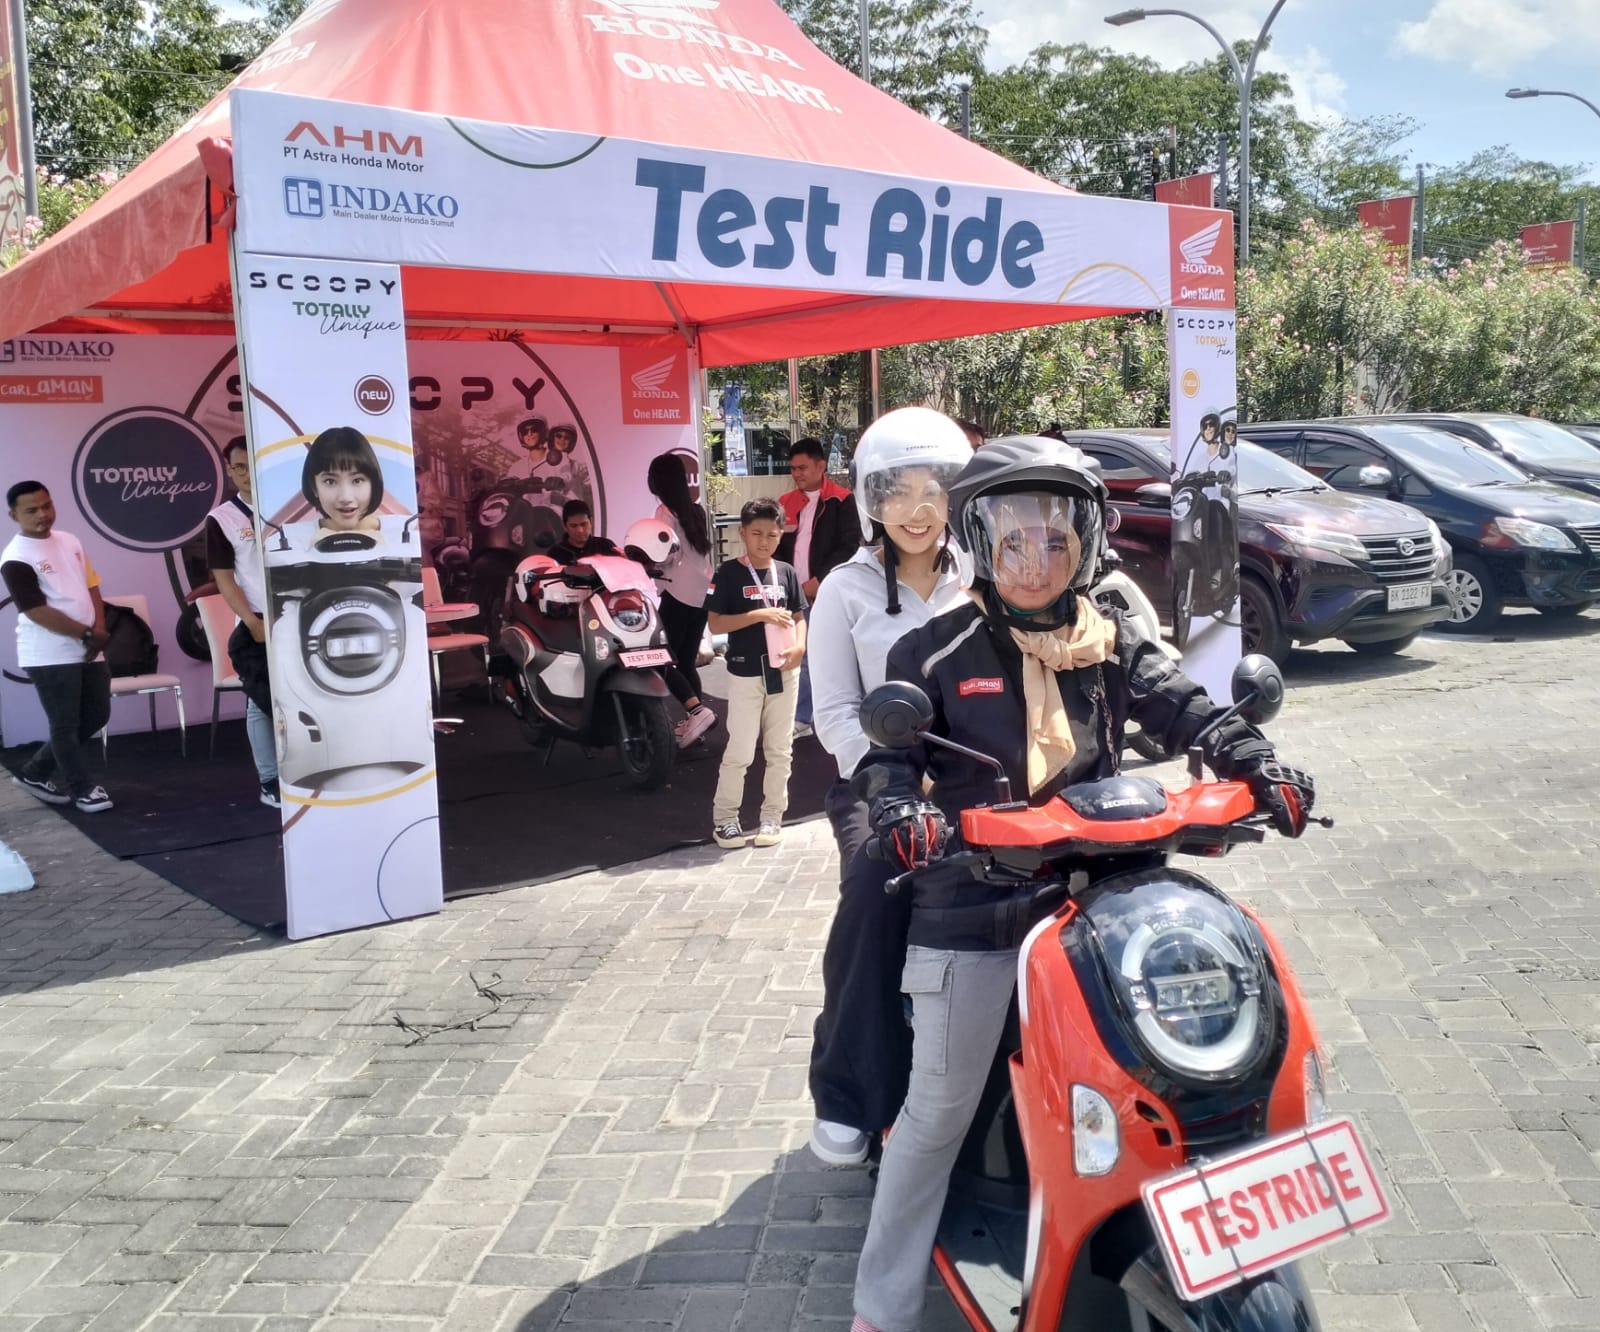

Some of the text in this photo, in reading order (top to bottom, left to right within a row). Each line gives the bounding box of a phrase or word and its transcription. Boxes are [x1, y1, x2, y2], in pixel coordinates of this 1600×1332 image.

[582, 14, 806, 71] HONDA
[612, 52, 707, 87] One
[284, 121, 424, 158] AHM
[283, 146, 425, 173] PT Astra Honda Motor
[327, 183, 459, 219] INDAKO
[333, 209, 352, 219] Main
[354, 211, 378, 221] Dealer
[380, 214, 402, 224] Motor
[404, 216, 429, 226] Honda
[635, 158, 1044, 289] Test Ride
[1180, 263, 1224, 275] HONDA
[250, 272, 396, 296] SCOOPY
[1180, 286, 1198, 300] One
[292, 301, 371, 319] TOTALLY
[320, 314, 401, 339] Unique
[1177, 317, 1235, 331] SCOOPY
[18, 340, 115, 357] INDAKO
[1195, 335, 1228, 346] TOTALLY
[632, 390, 680, 399] HONDA
[633, 408, 651, 419] One
[90, 466, 178, 484] TOTALLY
[121, 479, 212, 503] Unique
[626, 652, 664, 662] TEST RIDE
